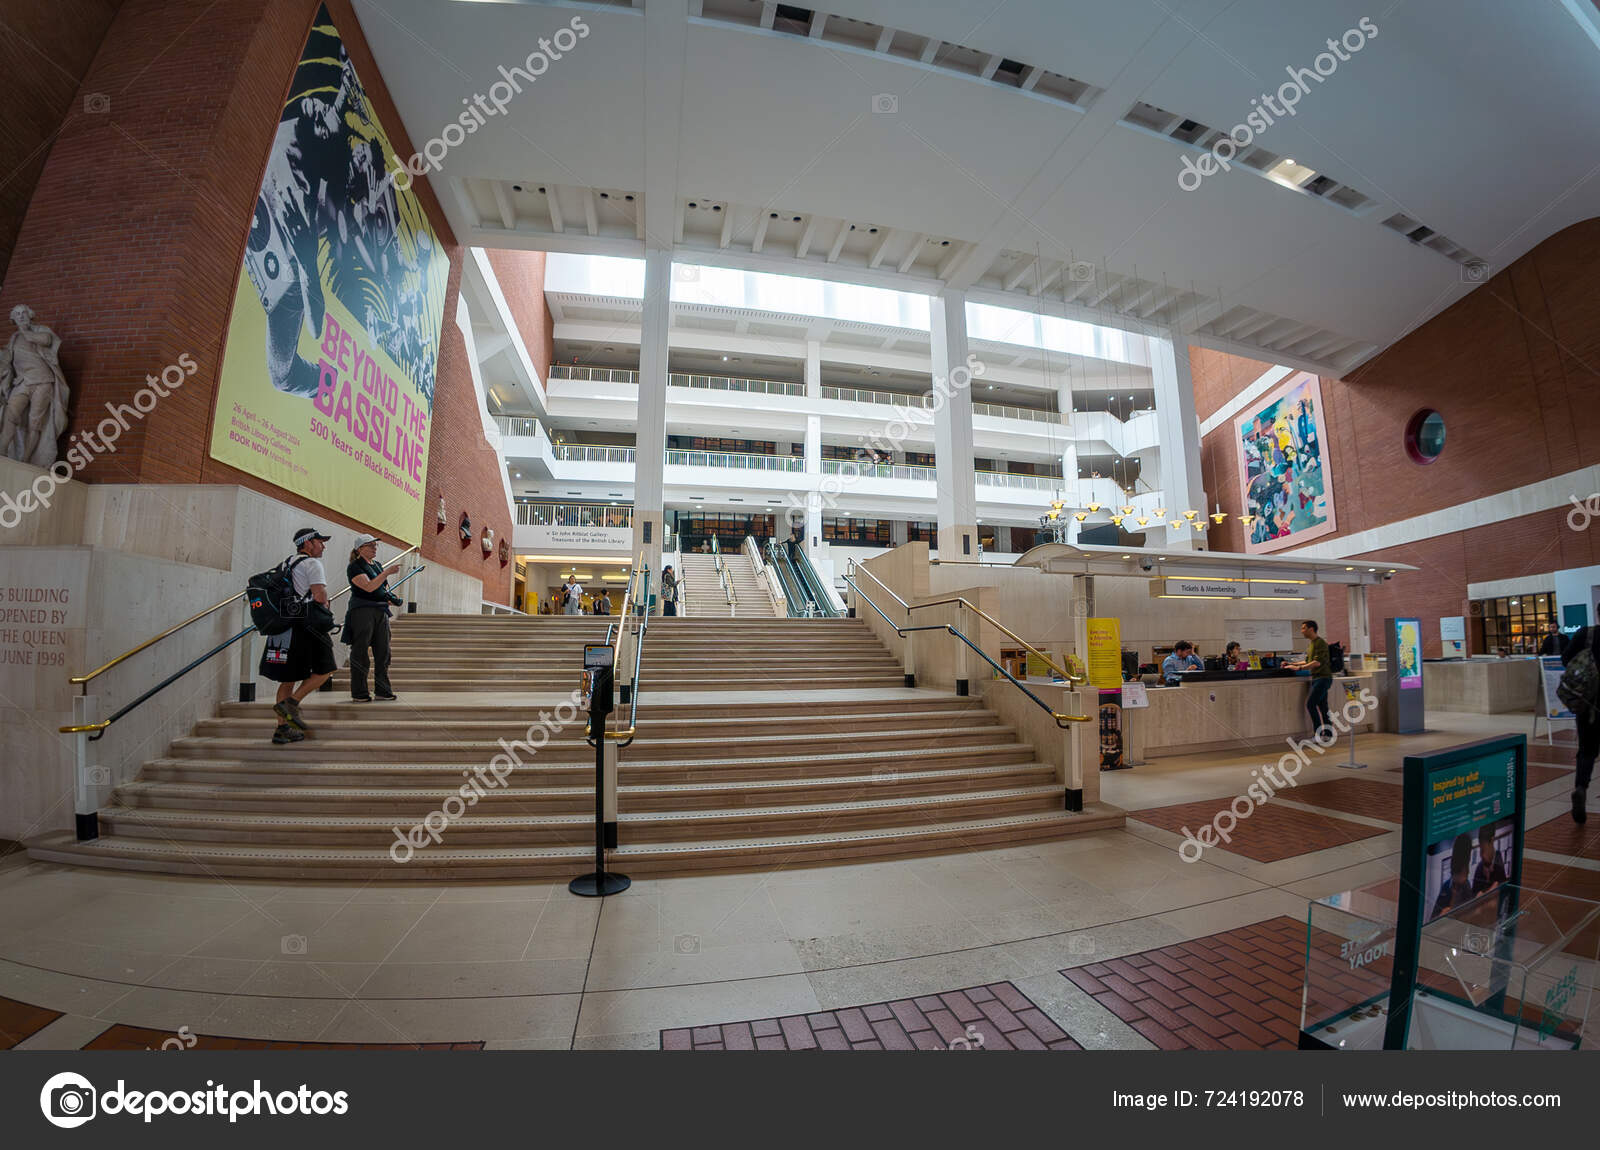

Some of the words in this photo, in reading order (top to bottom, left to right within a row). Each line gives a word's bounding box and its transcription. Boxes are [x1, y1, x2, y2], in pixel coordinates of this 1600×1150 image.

[320, 312, 399, 416] BEYOND
[402, 392, 428, 443] THE
[242, 408, 257, 421] April
[313, 358, 424, 484] BASSLINE
[229, 430, 250, 447] BOOK
[251, 441, 269, 456] NOW
[310, 417, 329, 441] 500
[331, 430, 353, 457] Years
[354, 450, 364, 463] of
[364, 454, 383, 476] Black
[383, 467, 403, 489] British
[403, 481, 420, 501] Music
[8, 588, 69, 604] BUILDING
[1181, 584, 1199, 593] Tickets
[1200, 585, 1205, 593] &
[1206, 585, 1237, 594] Membership
[51, 610, 68, 625] BY
[23, 630, 66, 648] QUEEN
[37, 651, 65, 666] 1998
